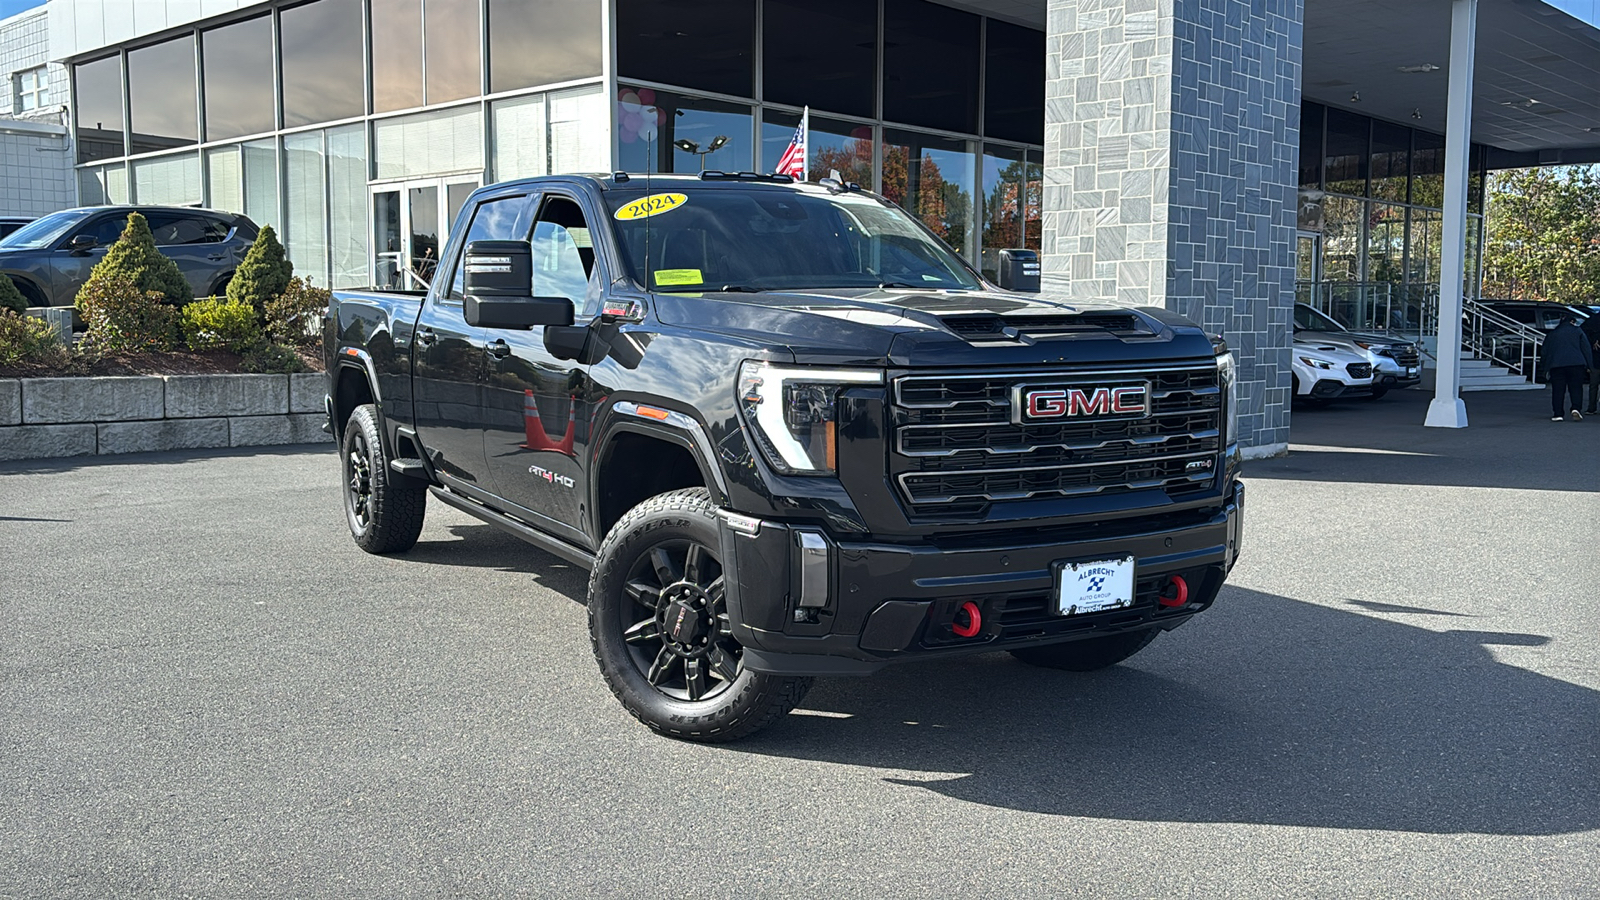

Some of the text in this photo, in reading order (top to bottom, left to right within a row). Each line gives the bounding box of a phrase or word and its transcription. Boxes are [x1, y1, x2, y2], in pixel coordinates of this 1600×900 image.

[629, 195, 676, 217] 2024
[1026, 386, 1146, 418] GMC
[1186, 459, 1212, 468] AT4
[528, 465, 575, 488] AT4 HD
[1078, 567, 1115, 581] ALBRECHT
[673, 606, 687, 637] GMC
